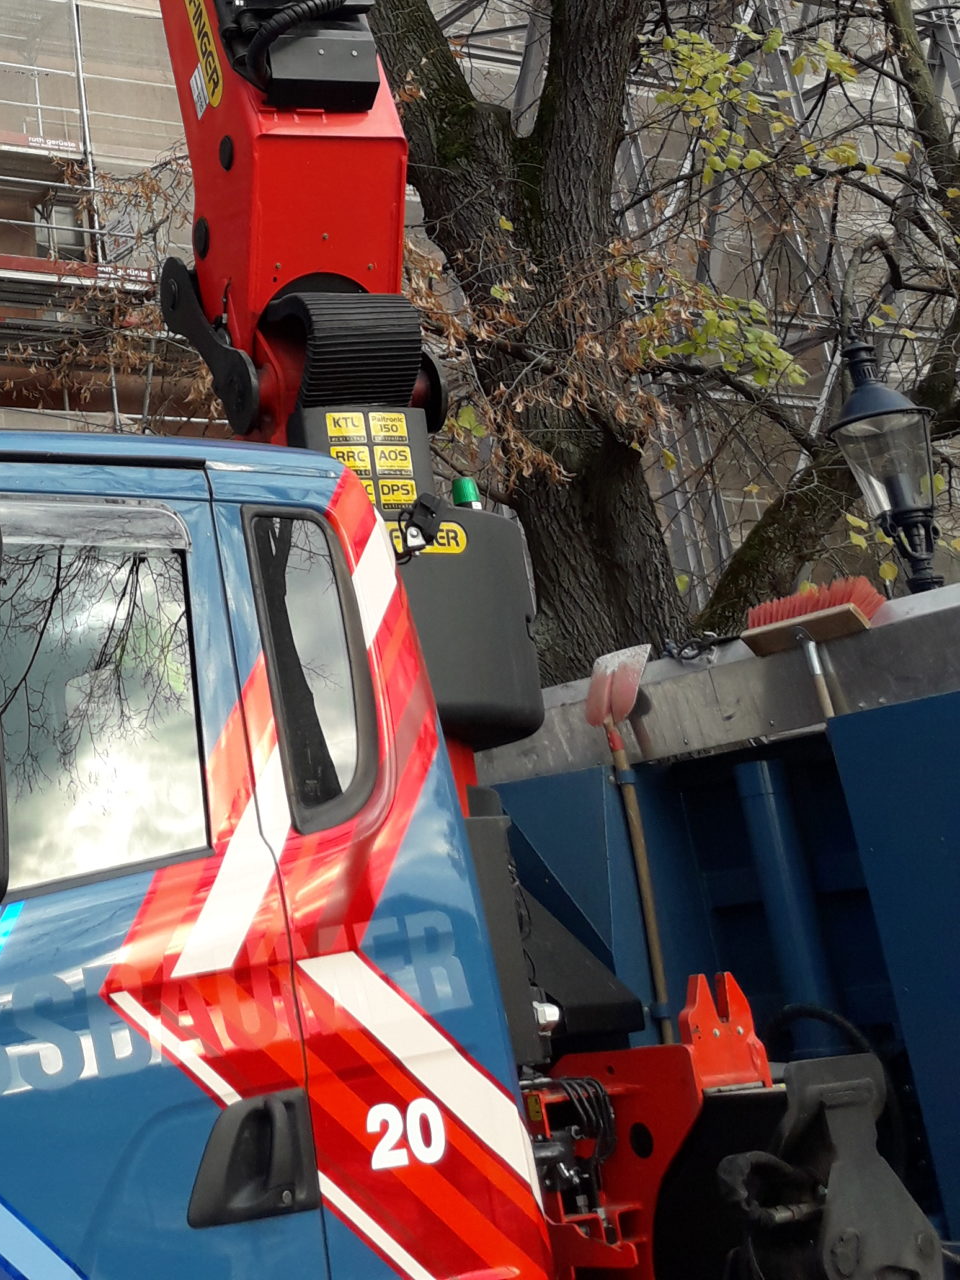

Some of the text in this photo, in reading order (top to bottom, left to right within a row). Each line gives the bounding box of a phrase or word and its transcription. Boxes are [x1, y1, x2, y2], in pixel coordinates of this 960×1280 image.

[332, 416, 359, 429] KTL
[335, 450, 366, 463] RRC
[378, 449, 408, 462] AOS
[366, 1097, 446, 1170] 20
